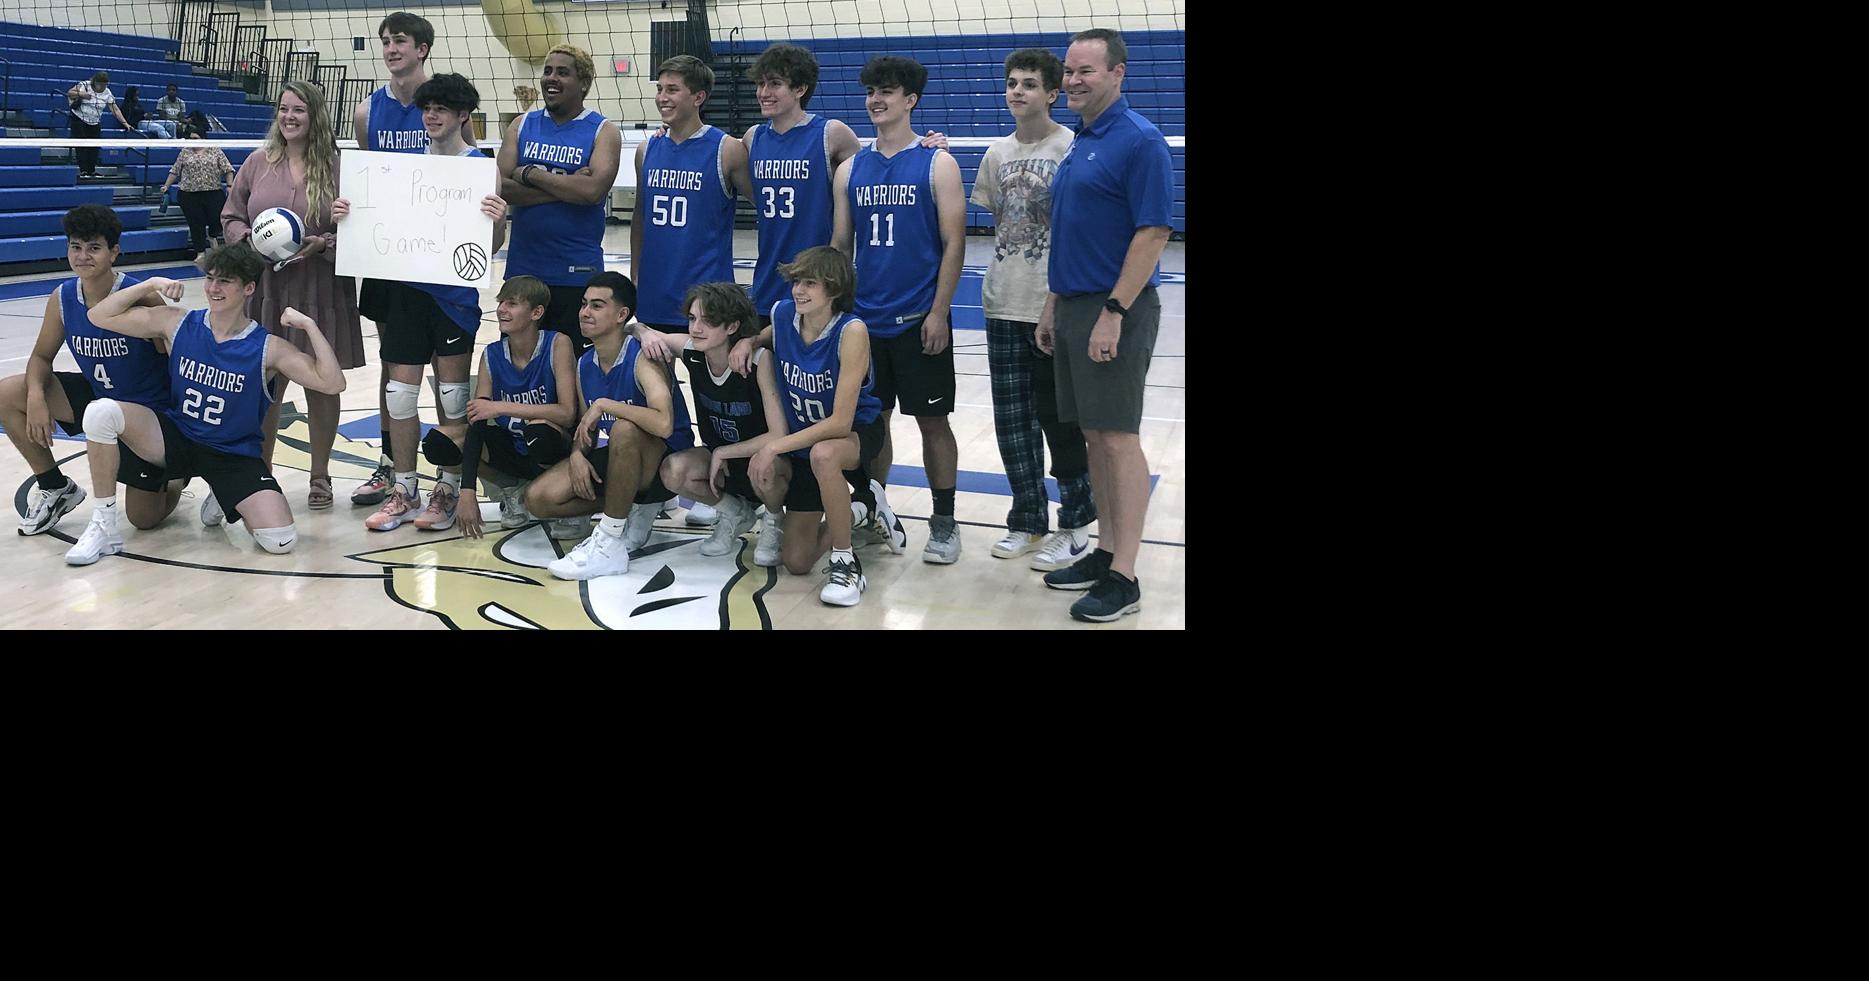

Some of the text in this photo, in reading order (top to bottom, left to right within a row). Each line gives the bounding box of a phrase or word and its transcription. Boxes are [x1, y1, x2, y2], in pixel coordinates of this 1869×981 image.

[377, 129, 432, 149] WARRIORS
[523, 141, 583, 165] WARRIORS
[648, 168, 703, 191] WARRIORS
[754, 159, 810, 180] WARRIORS
[411, 168, 473, 217] Program
[761, 186, 795, 219] 33
[855, 184, 917, 207] WARRIORS
[652, 195, 688, 227] 50
[253, 218, 275, 234] Wilson
[869, 213, 895, 246] 11
[93, 363, 114, 389] 4
[178, 356, 245, 393] WARRIORS
[780, 360, 834, 393] ARRIORS
[182, 387, 226, 425] 22
[789, 390, 825, 423] 20
[709, 415, 740, 442] 15
